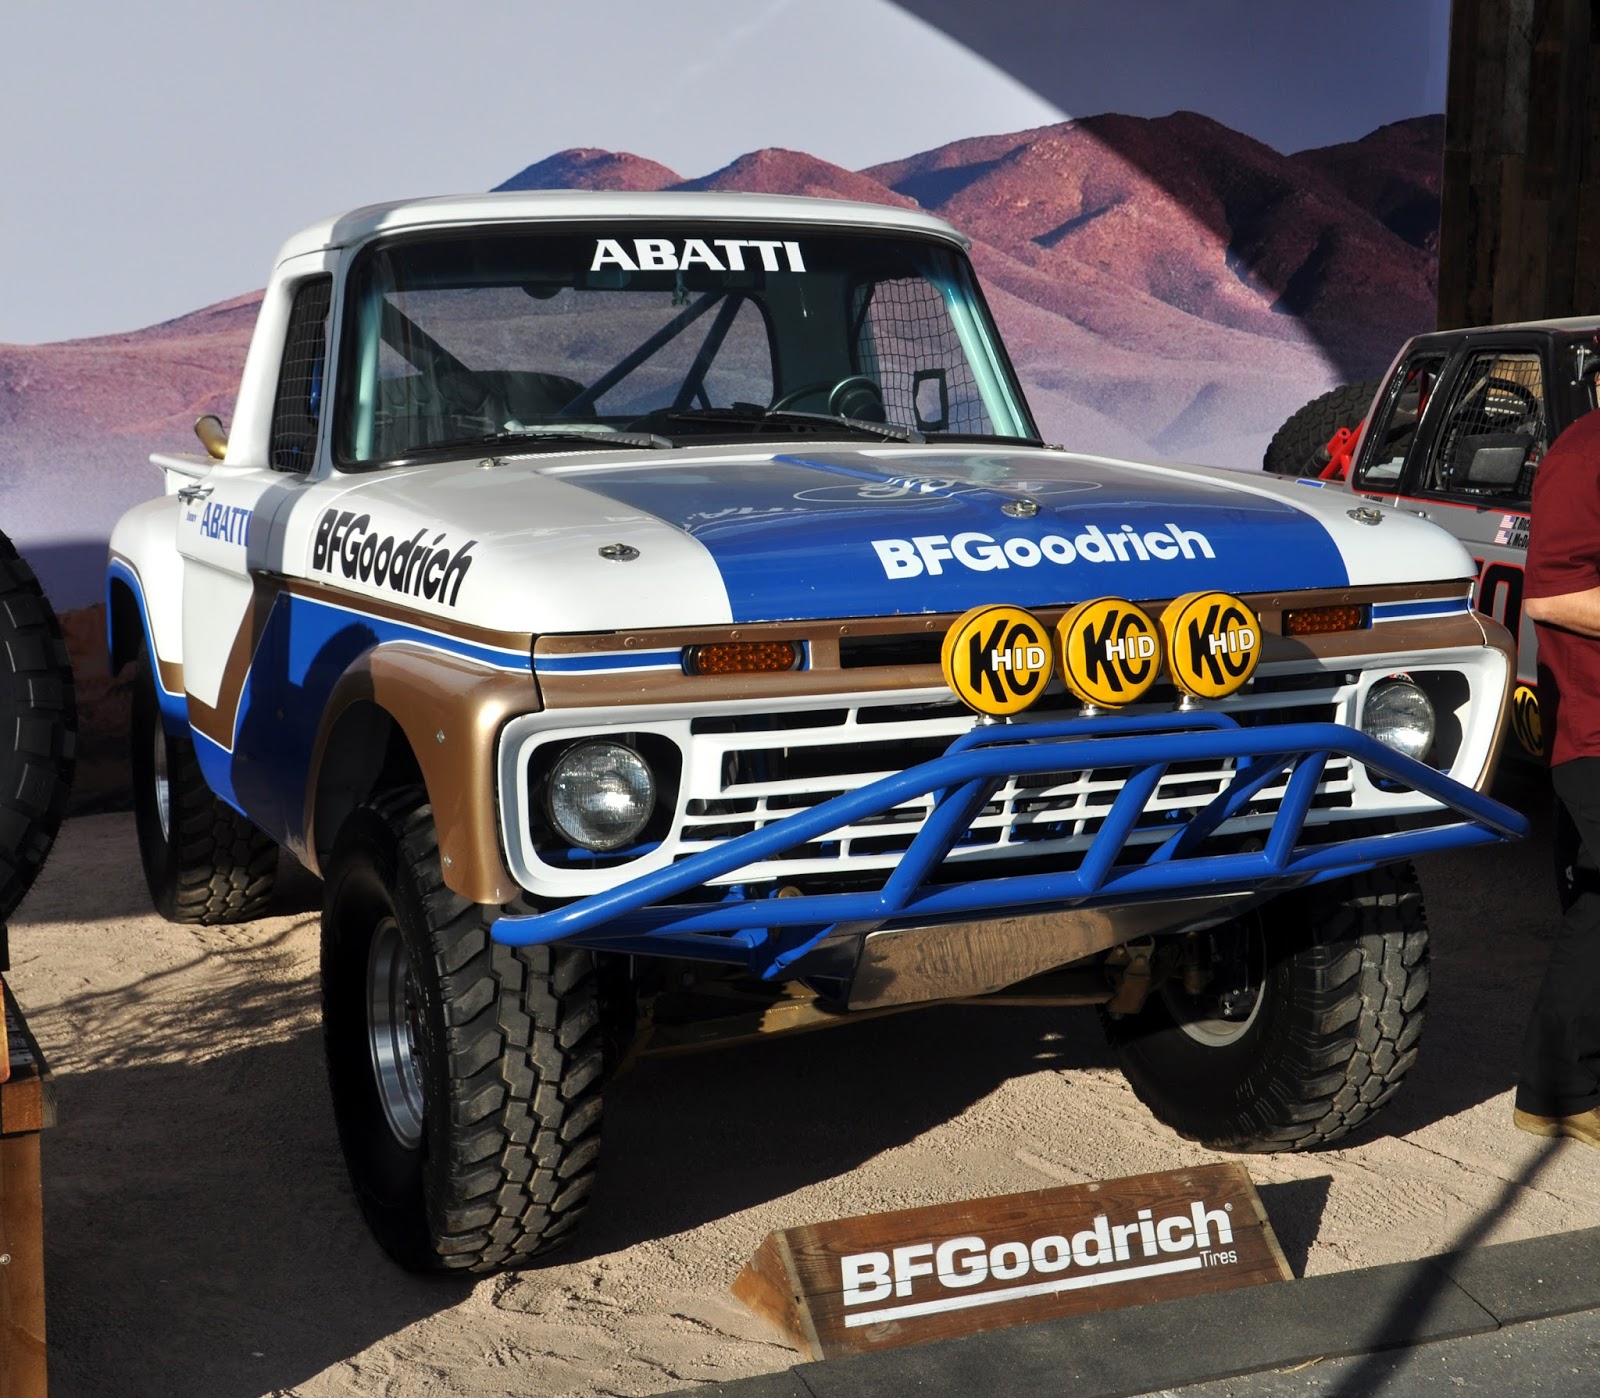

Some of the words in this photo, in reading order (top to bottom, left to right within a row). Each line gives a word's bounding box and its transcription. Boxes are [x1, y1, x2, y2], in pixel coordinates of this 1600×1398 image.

[590, 239, 806, 273] ABATTI
[200, 502, 253, 548] ABATTI
[871, 523, 1216, 580] BFGoodrich
[313, 508, 479, 607] BFGoodrich
[970, 619, 1040, 703] KC
[991, 647, 1046, 671] HID
[1083, 609, 1151, 692] KC
[1105, 636, 1155, 661] HID
[1188, 604, 1250, 685] KC
[1208, 629, 1255, 655] HID
[1513, 691, 1544, 750] KC
[841, 1201, 1234, 1306] BFGoodrich
[1200, 1250, 1238, 1267] Tires
